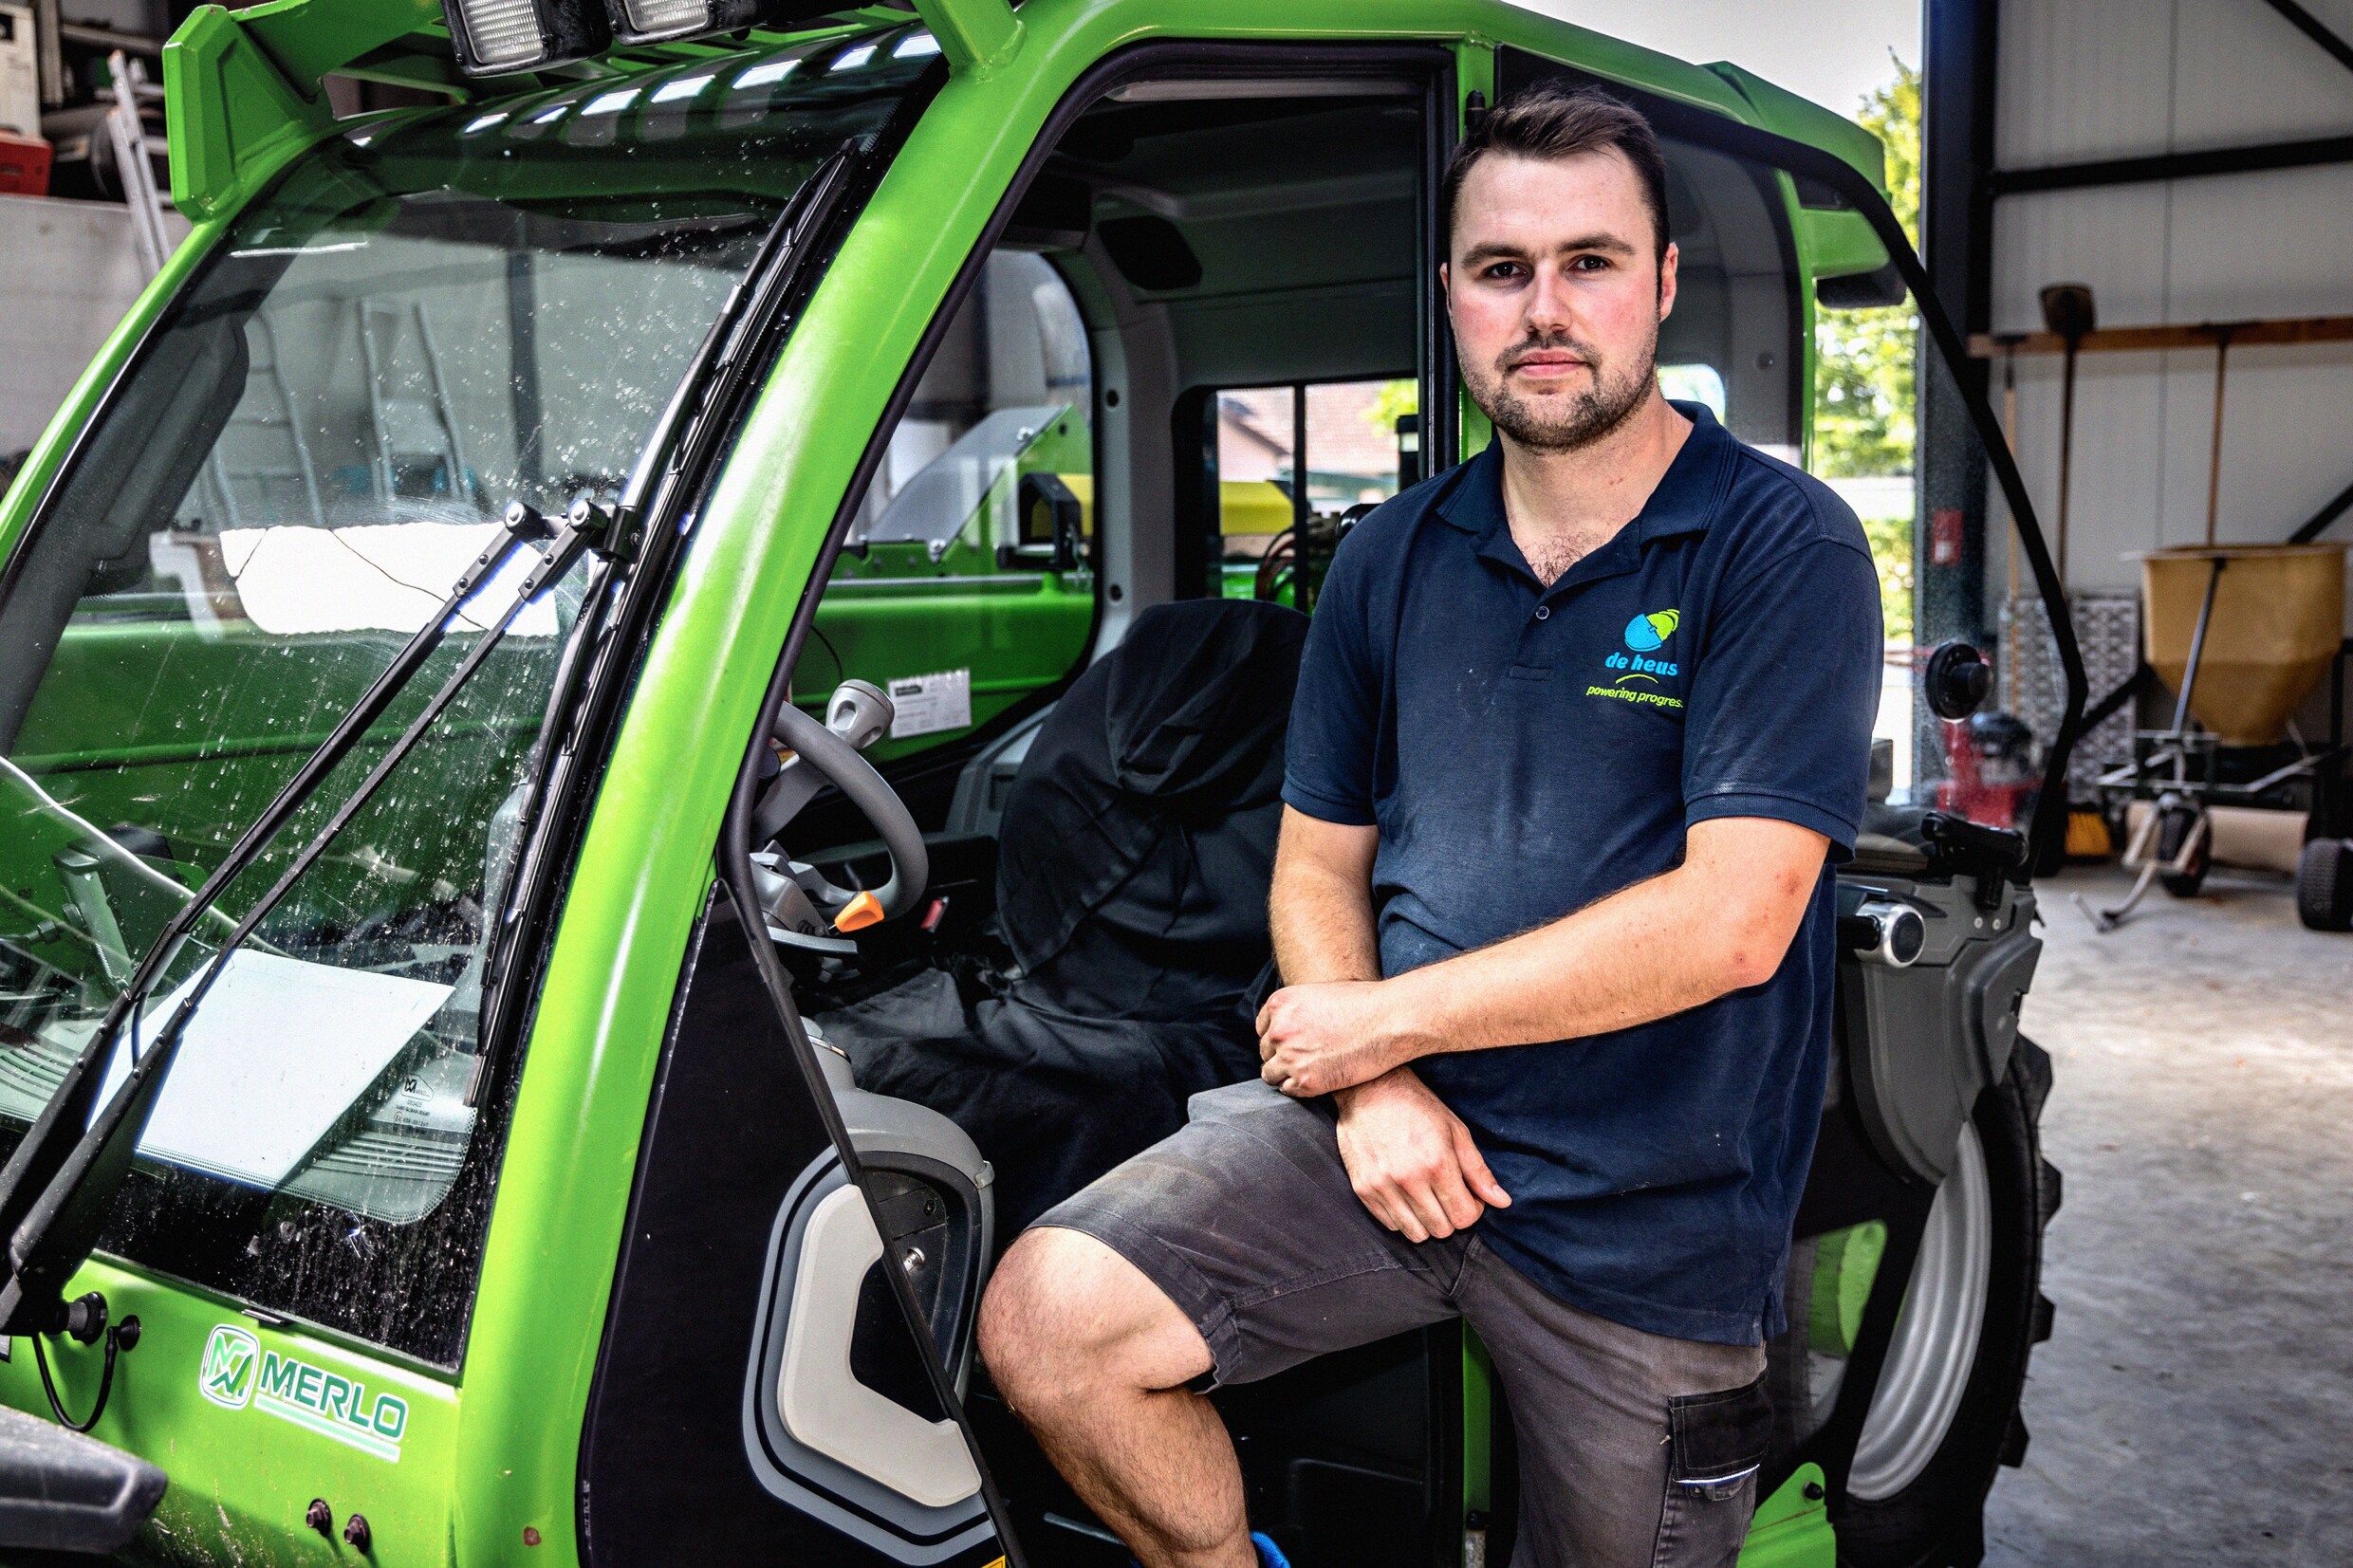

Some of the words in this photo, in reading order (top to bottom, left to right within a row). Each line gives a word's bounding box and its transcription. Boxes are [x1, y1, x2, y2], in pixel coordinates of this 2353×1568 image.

[1605, 652, 1629, 669] de
[1631, 655, 1678, 675] heus
[1585, 686, 1638, 702] powering
[1636, 692, 1683, 708] progres
[259, 1353, 407, 1439] MERLO
